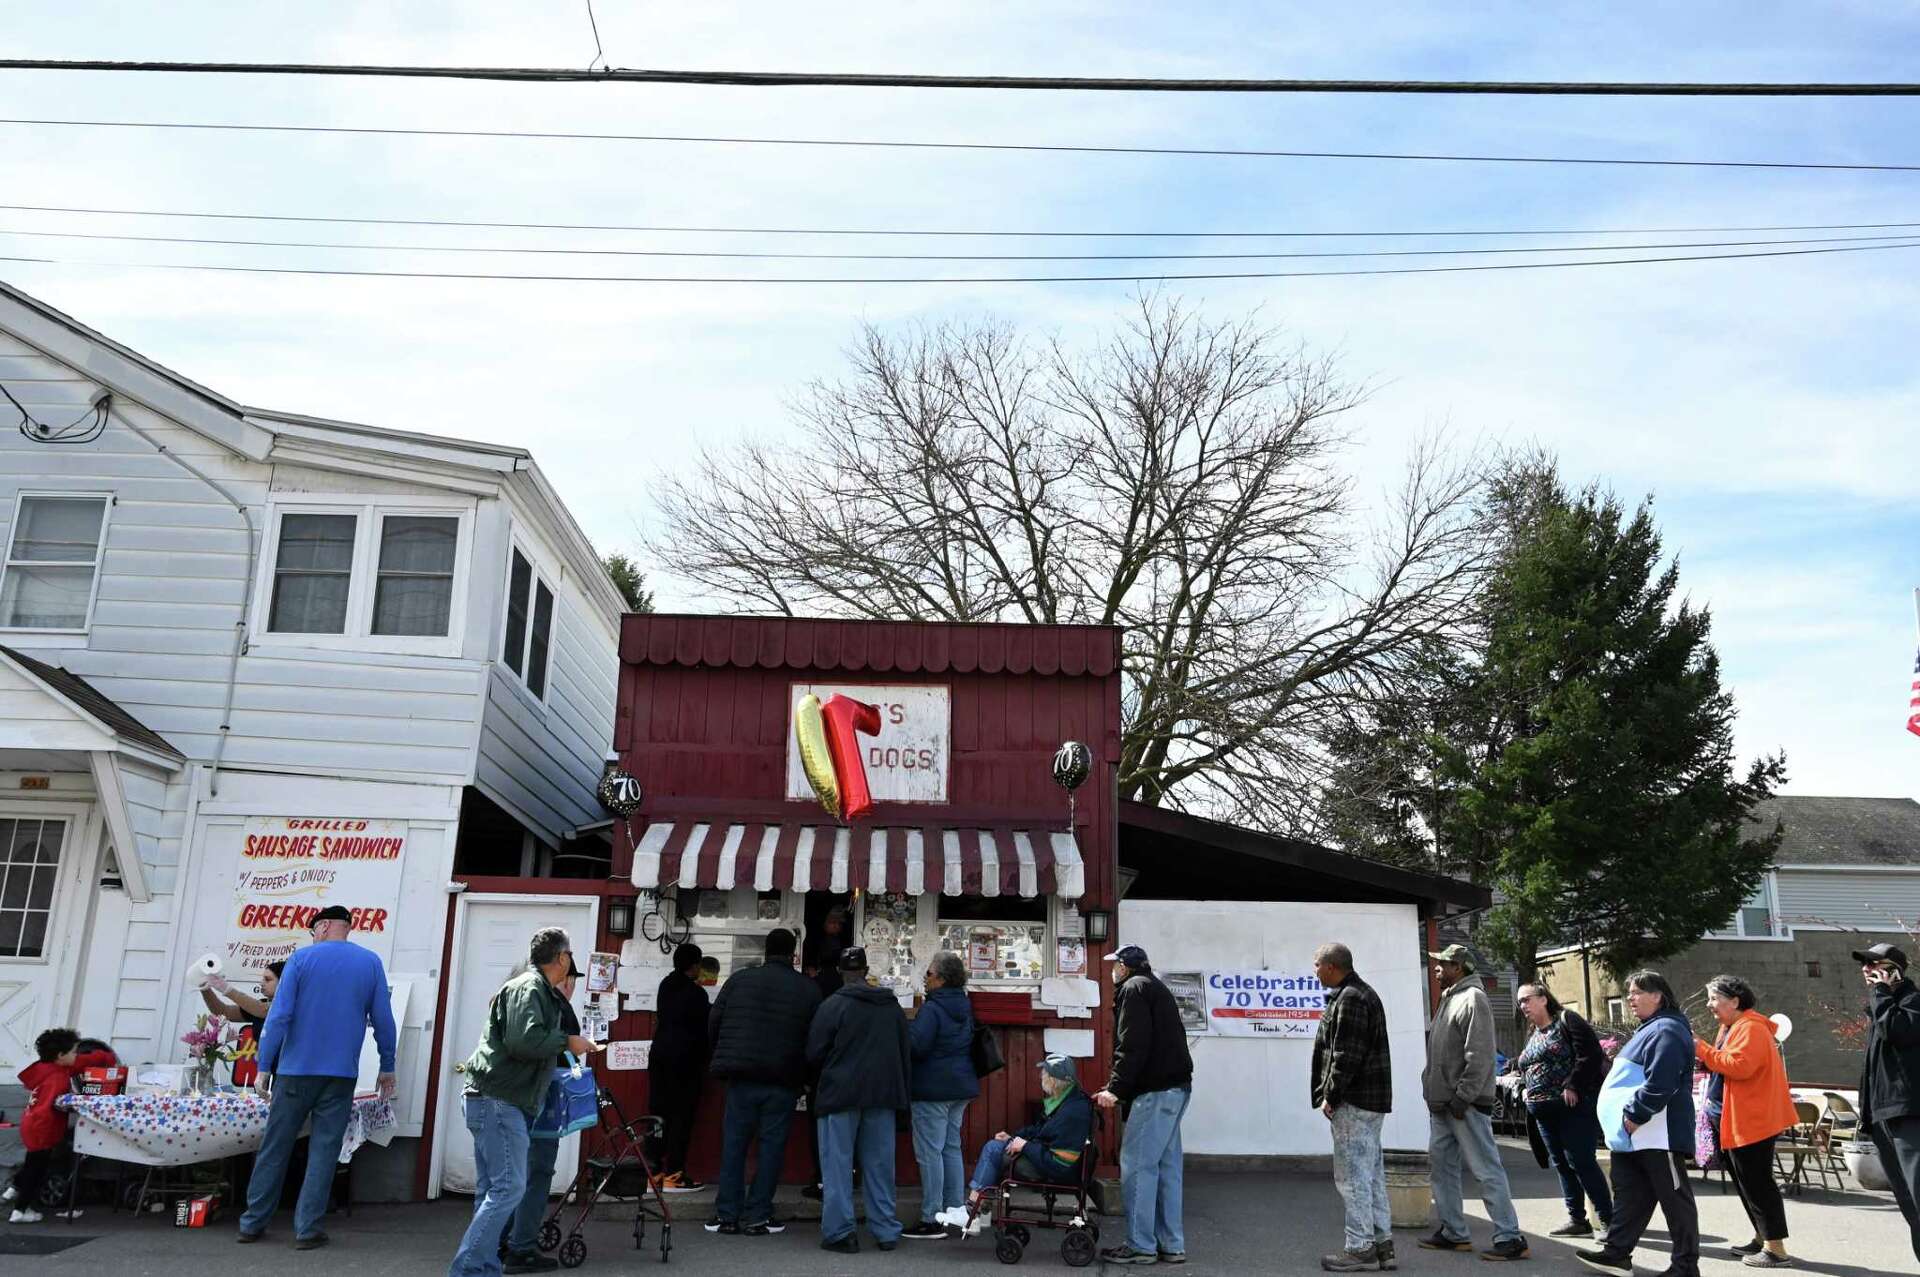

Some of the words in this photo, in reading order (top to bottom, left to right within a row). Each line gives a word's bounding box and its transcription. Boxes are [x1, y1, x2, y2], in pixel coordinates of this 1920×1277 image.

[869, 748, 933, 769] DOGS
[612, 777, 641, 801] 70
[244, 834, 319, 860] SAUSAGE
[319, 836, 404, 861] SANDWICH
[250, 873, 289, 890] PEPPERS
[241, 904, 388, 931] GREEKBGER
[240, 944, 264, 956] FRIED
[265, 942, 297, 957] ONIONS
[1225, 992, 1251, 1007] 70
[1288, 1009, 1310, 1018] 1954
[1248, 1022, 1280, 1033] Thank
